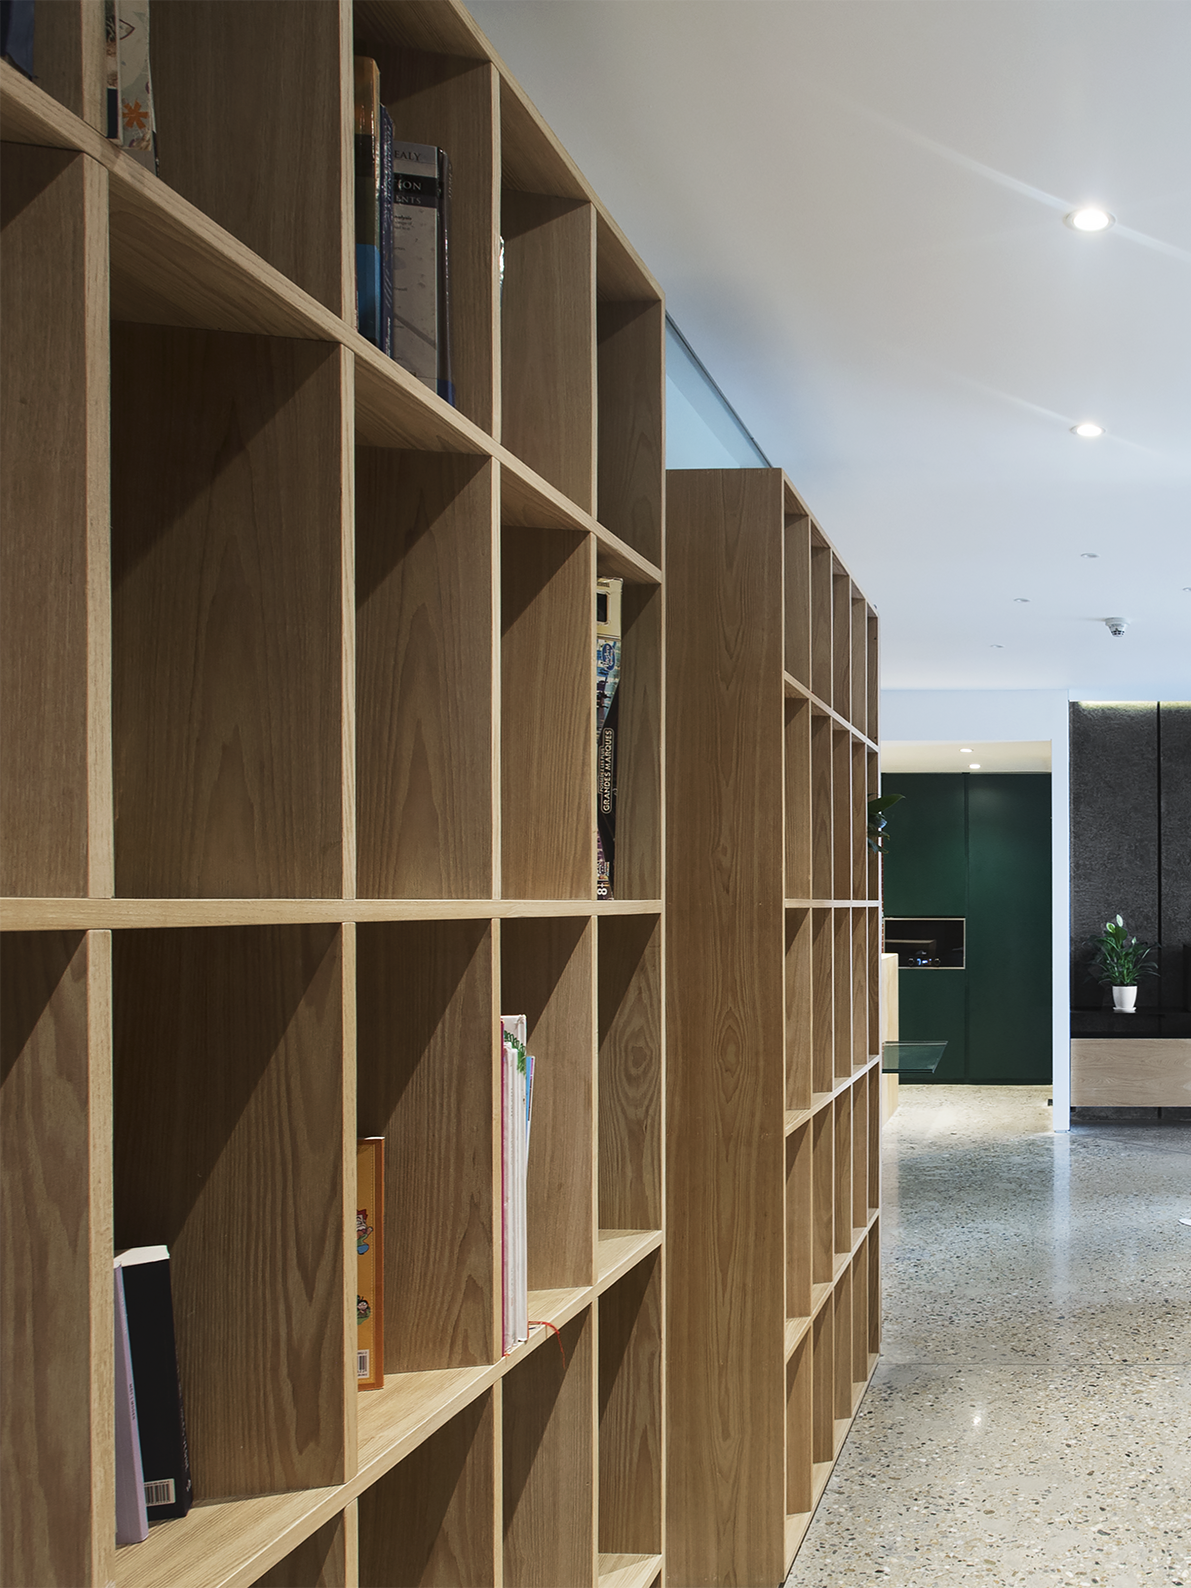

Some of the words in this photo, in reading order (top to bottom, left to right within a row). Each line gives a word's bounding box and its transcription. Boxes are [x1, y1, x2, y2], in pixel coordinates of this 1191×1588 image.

[394, 150, 421, 161] EALY
[394, 178, 421, 191] ION
[395, 195, 421, 204] ENTS
[604, 730, 613, 770] MARQUES
[603, 772, 611, 811] GRANDES
